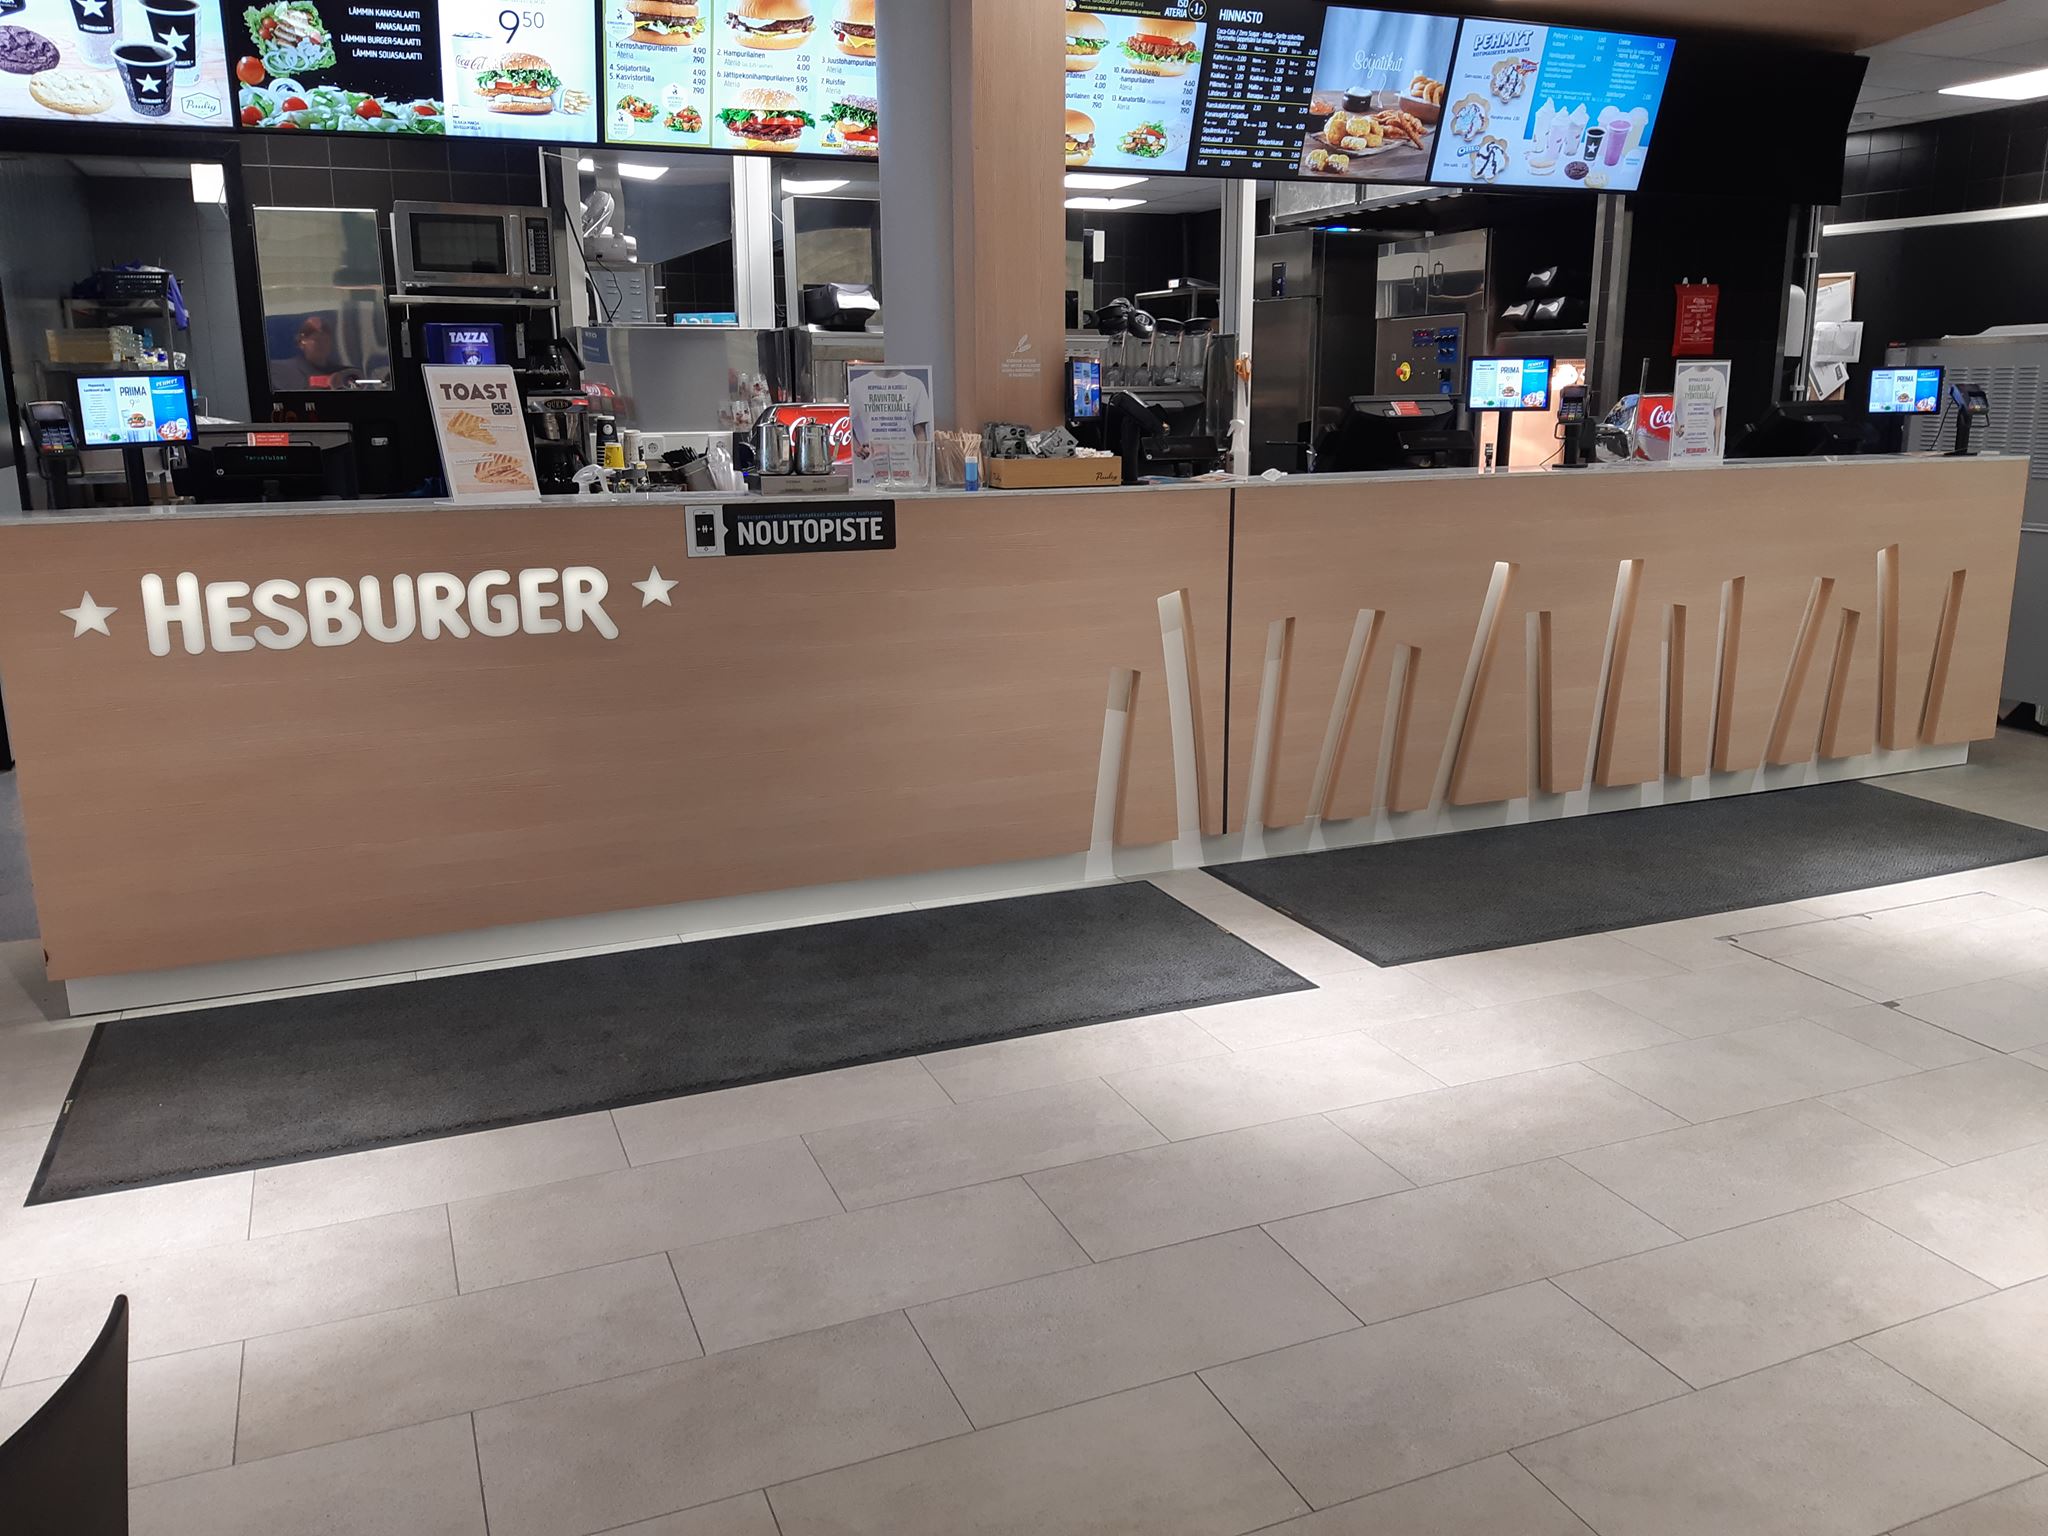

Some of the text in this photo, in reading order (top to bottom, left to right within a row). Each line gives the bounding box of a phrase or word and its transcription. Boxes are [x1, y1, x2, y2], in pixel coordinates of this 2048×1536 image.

[349, 7, 420, 19] LÄMMIN KANASALAATTI
[1164, 7, 1188, 18] ATERIA
[1219, 9, 1263, 24] HINNASTO
[376, 22, 420, 32] KANASALAATTI
[341, 34, 421, 46] LÄMMIN BURGER-SALAATTI
[1474, 30, 1534, 51] PEHMYT
[616, 42, 677, 52] Kerroshampurilainen
[353, 49, 377, 58] LÄMMIN
[724, 50, 765, 59] Hampurilainen
[828, 57, 876, 66] Juustohampurilain
[1353, 50, 1405, 79] Soijatikut
[616, 64, 650, 73] Soijatortilla
[616, 73, 655, 82] Kasvistortilla
[723, 71, 794, 82] Jättipekonihampurilainen
[1119, 96, 1146, 104] Kanatortilla
[449, 332, 488, 343] TAZZA
[119, 386, 147, 397] PRIIMA
[440, 383, 508, 400] TOAST
[869, 394, 905, 402] RAVINTOLA-
[864, 402, 912, 412] TYÖNTEKIJÄLLE
[737, 517, 884, 546] NOUTOPISTE
[140, 565, 620, 657] HESBURGER
